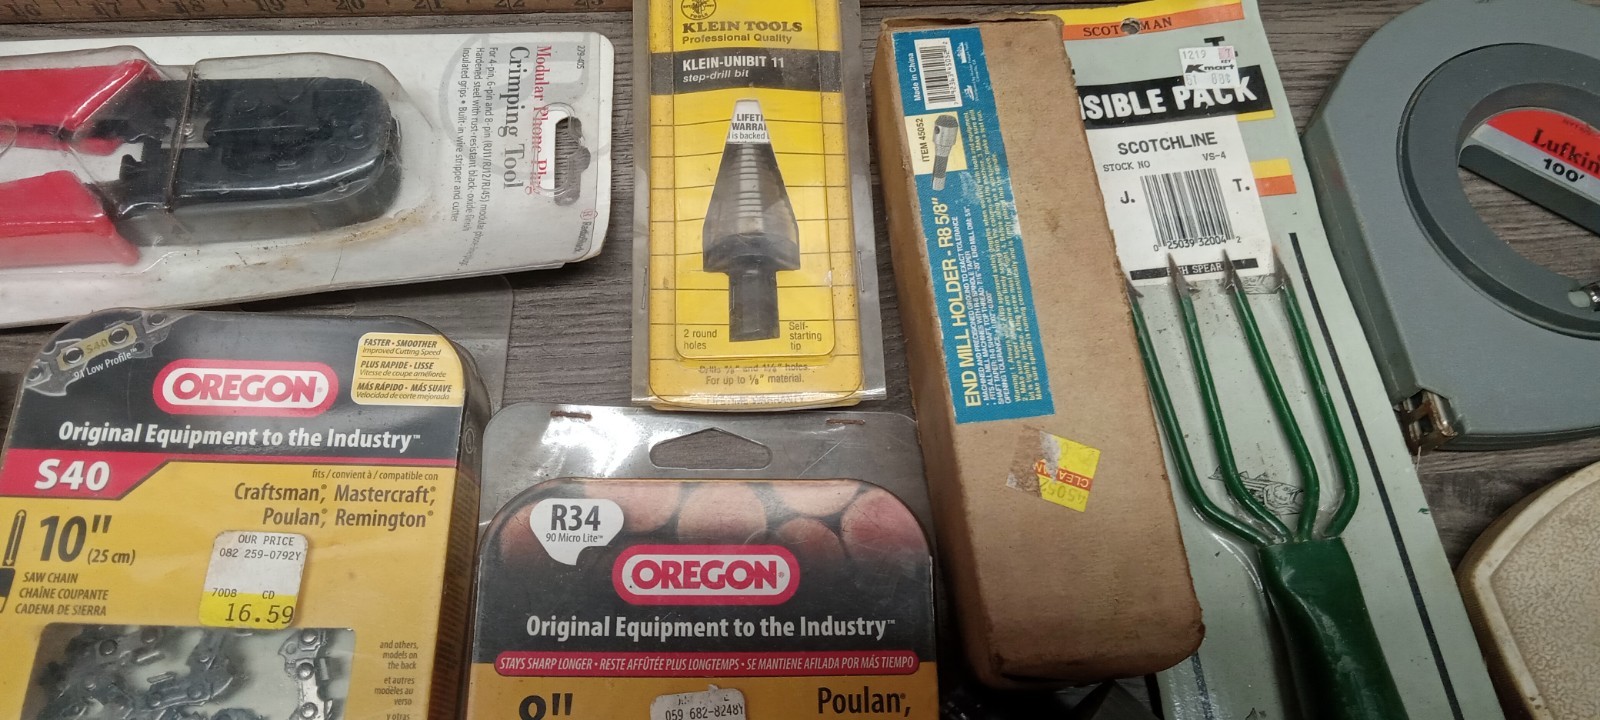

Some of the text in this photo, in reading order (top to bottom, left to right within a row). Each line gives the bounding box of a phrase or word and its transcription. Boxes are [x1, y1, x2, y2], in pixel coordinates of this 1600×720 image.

[682, 21, 802, 33] KLEIN TOOLS
[1083, 17, 1172, 36] SCOTMAN
[682, 34, 792, 44] Professional Quality
[577, 45, 585, 70] 279-405
[682, 56, 784, 72] KLEIN-UNIBIT 11
[906, 51, 916, 72] China
[1182, 50, 1206, 60] 1219
[488, 58, 497, 80] 4-pin,
[683, 69, 749, 83] step-drill bit
[484, 82, 496, 102] 6-pin
[911, 81, 921, 101] Made
[468, 48, 484, 168] Hardened steel with rust-resistant
[498, 46, 530, 189] Crimping Tool
[452, 47, 471, 199] Insulated grips Built-in wire stripper and
[482, 118, 494, 139] 8-pin
[525, 45, 552, 195] Modular Phone Plug
[915, 117, 930, 162] ITEM 45052
[1118, 132, 1218, 155] SCOTCHLINE
[1532, 128, 1600, 174] Lufkin
[1103, 151, 1226, 172] STOCK NO VS-4
[1543, 158, 1585, 182] 100'
[1120, 178, 1250, 204] J. T.
[951, 216, 962, 251] TOLERANCE
[1167, 236, 1226, 250] 25039 32004
[957, 252, 966, 272] EXACT
[1192, 262, 1222, 274] SPEAR
[931, 195, 981, 408] END MILL HOLDER R8 5/8"
[962, 282, 973, 310] GROUND
[684, 329, 717, 338] 2 round
[789, 322, 808, 330] Self-
[86, 338, 108, 354] S40
[396, 340, 437, 348] SMOOTHER
[684, 340, 706, 349] holes
[790, 332, 822, 342] starting
[791, 342, 801, 350] tip
[975, 352, 983, 366] AND
[86, 363, 103, 375] Low
[172, 372, 317, 402] OREGON
[357, 381, 374, 390] MÁS
[375, 382, 404, 390] RÁPIDO
[410, 382, 427, 392] MÁS
[706, 376, 720, 384] For
[723, 378, 734, 386] up
[737, 376, 745, 384] to
[768, 374, 804, 383] material.
[977, 366, 989, 401] MACHINED
[59, 421, 142, 446] Original
[146, 424, 256, 448] Equipment
[268, 430, 283, 446] to
[288, 428, 316, 447] the
[34, 459, 110, 491] S40
[312, 469, 325, 478] fits
[332, 470, 365, 479] convient
[379, 471, 422, 482] compatible
[551, 504, 600, 531] R34
[40, 514, 112, 562] 10"
[238, 534, 294, 546] OUR PRICE
[546, 534, 556, 542] 90
[558, 533, 581, 542] Micro
[88, 548, 135, 565] (25 cm)
[219, 548, 301, 562] 082 259-0792Y
[23, 572, 78, 584] SAW CHAIN
[632, 560, 777, 590] OREGON
[19, 586, 109, 600] CHAÎNE COUPANTE
[262, 590, 275, 600] CD
[15, 604, 107, 616] CADENA DE SIERRA
[225, 603, 294, 624] 16.59
[527, 615, 610, 642] Original
[616, 616, 728, 642] Equipment
[734, 618, 755, 636] to
[760, 616, 794, 637] the
[500, 654, 914, 670] STAYS SHARP LONGER RESTE AFFÛTÉE PLUS LONGTEMPS SE MANTIENE AFILADA POR MÁS TIEMPO
[666, 703, 743, 720] 059 682-8248Y
